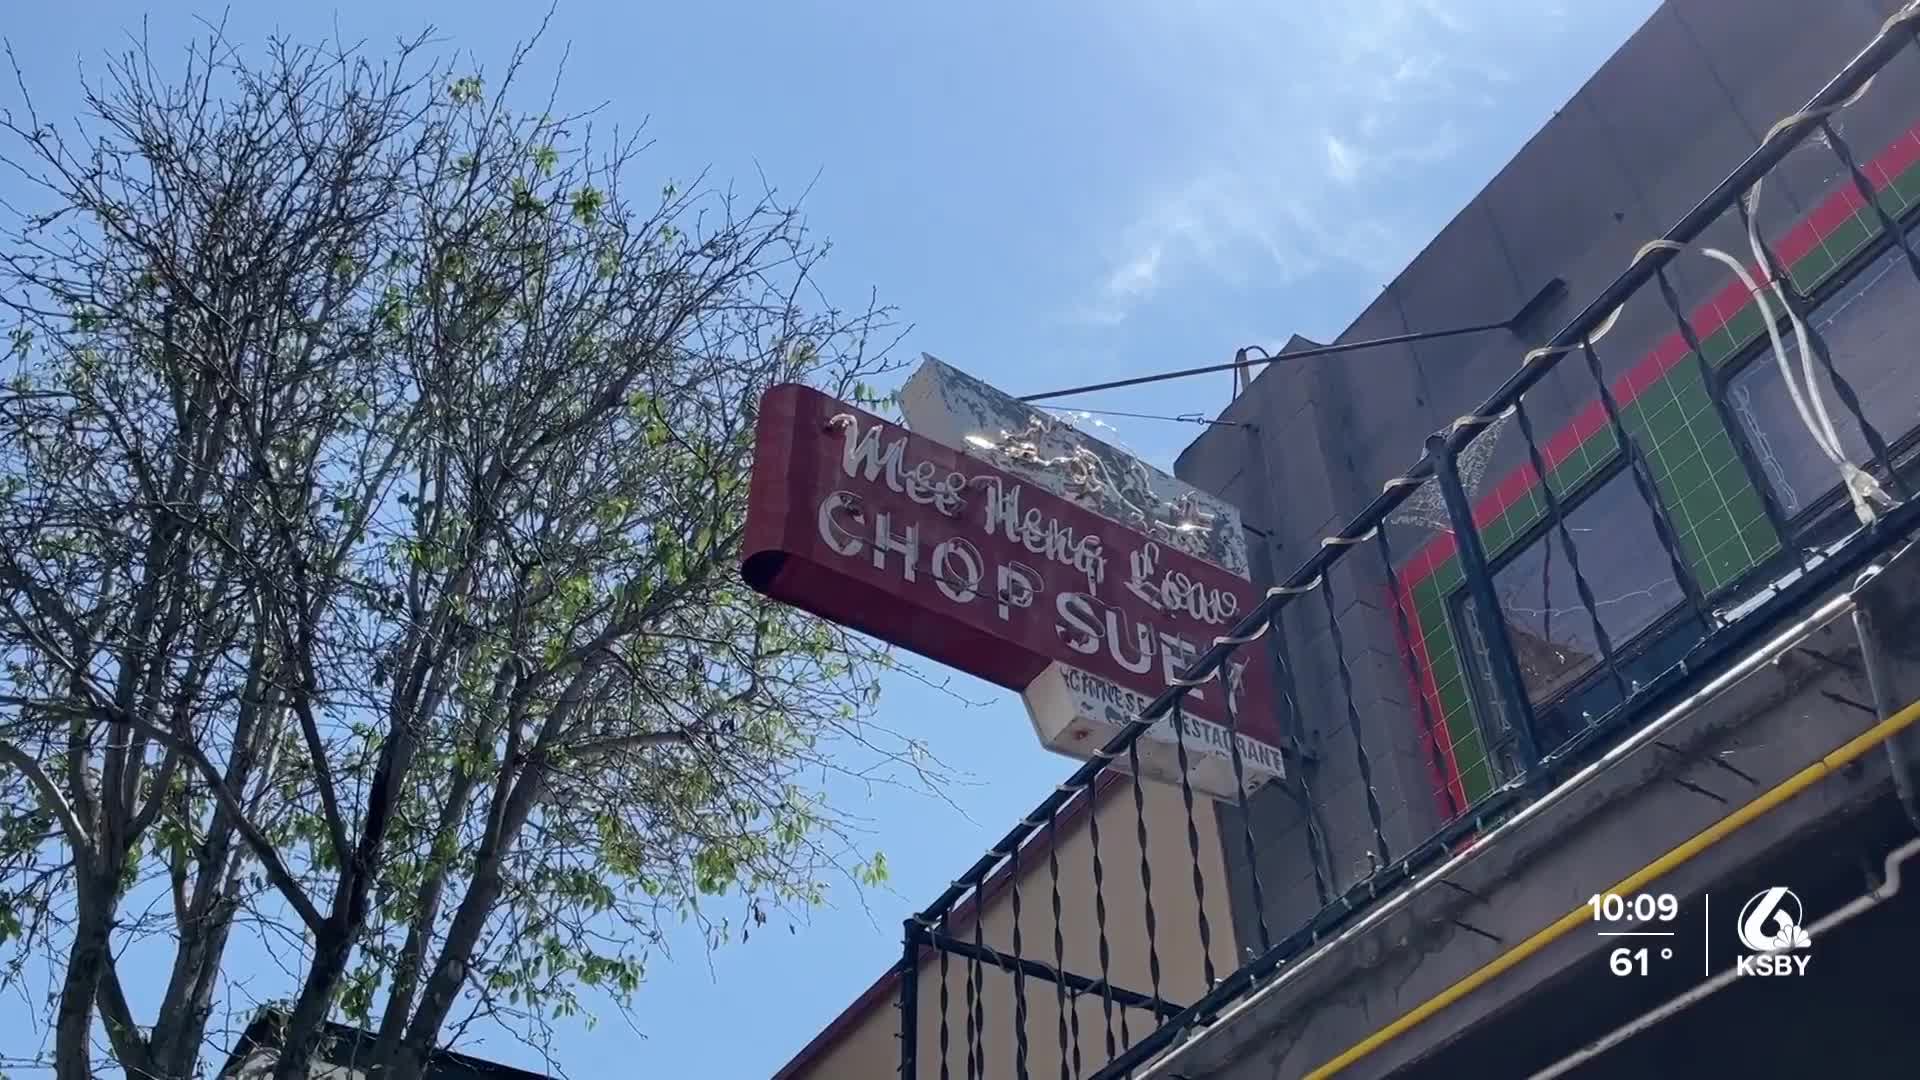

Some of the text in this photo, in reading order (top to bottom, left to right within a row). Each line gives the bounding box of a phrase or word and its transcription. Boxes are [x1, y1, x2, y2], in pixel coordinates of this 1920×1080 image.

[818, 490, 1042, 621] CHOP
[830, 413, 967, 516] Mee
[971, 474, 1106, 595] Heng
[1123, 541, 1240, 624] Low
